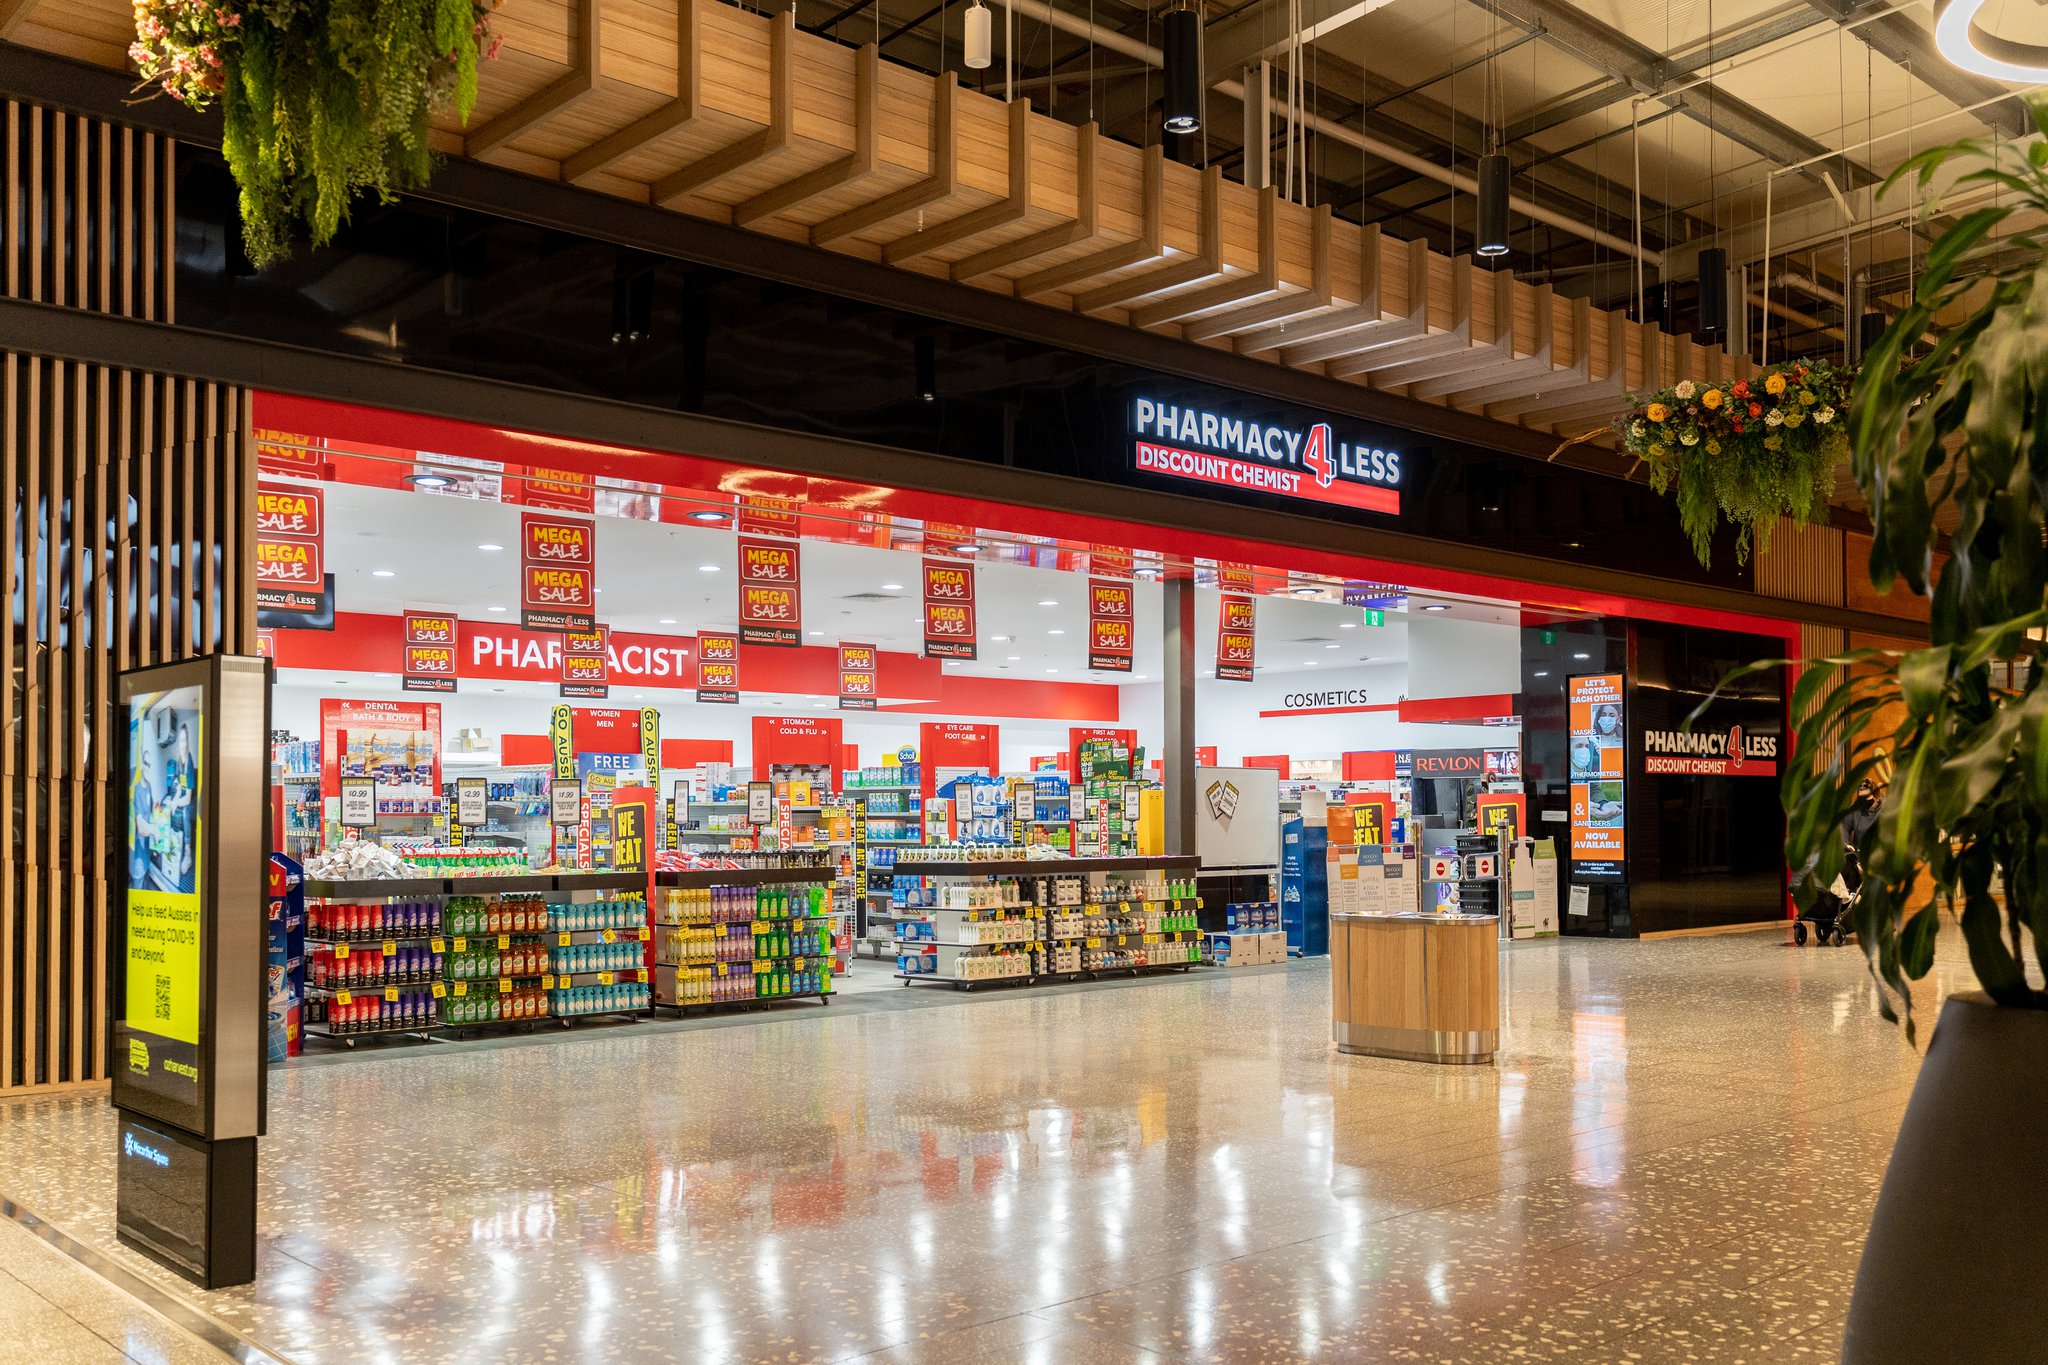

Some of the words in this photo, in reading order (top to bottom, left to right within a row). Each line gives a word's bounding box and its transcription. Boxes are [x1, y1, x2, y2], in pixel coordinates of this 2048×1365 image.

[1137, 398, 1302, 464] PHARMACY
[1303, 422, 1337, 489] 4
[1341, 443, 1400, 484] LESS
[1140, 445, 1230, 480] DISCOUNT
[1231, 463, 1300, 493] CHEMIST
[534, 527, 583, 546] MEGA
[539, 543, 582, 559] SALE
[748, 550, 789, 567] MEGA
[752, 563, 788, 579] SALE
[534, 571, 583, 589] MEGA
[929, 570, 965, 586] MEGA
[539, 586, 582, 603] SALE
[933, 583, 964, 597] SALE
[1095, 588, 1126, 603] MEGA
[296, 596, 316, 605] LESS
[748, 589, 789, 606] MEGA
[753, 603, 789, 619] SALE
[1099, 601, 1126, 614] SALE
[528, 614, 565, 625] PHARMACY
[574, 616, 589, 626] LESS
[930, 607, 966, 622] MEGA
[412, 619, 449, 631] MEGA
[934, 619, 965, 634] SALE
[1096, 622, 1127, 637] MEGA
[416, 630, 448, 641] SALE
[744, 630, 775, 638] PHARMACY
[1100, 634, 1126, 647] SALE
[573, 641, 601, 650] SALE
[704, 639, 732, 649] MEGA
[928, 644, 953, 652] PHARMACY
[412, 649, 449, 661] MEGA
[473, 635, 688, 676] PHARACIST
[707, 648, 732, 658] SALE
[845, 650, 869, 659] MEGA
[1228, 647, 1251, 659] SALE
[416, 659, 448, 671] SALE
[569, 658, 601, 669] MEGA
[847, 658, 869, 667] SALE
[1093, 656, 1115, 664] PHARMACY
[572, 668, 601, 678] SALE
[704, 665, 732, 675] MEGA
[407, 679, 435, 687] PHARMACY
[707, 675, 732, 684] SALE
[845, 674, 870, 684] MEGA
[1585, 679, 1606, 687] LET'S
[847, 683, 870, 692] SALE
[1577, 686, 1614, 695] PROTECT
[1285, 689, 1367, 708] COSMETICS
[1571, 695, 1595, 703] EACH
[1596, 694, 1621, 703] OTHER
[365, 702, 399, 711] DENTAL
[353, 713, 376, 721] BATH
[378, 713, 385, 721] &
[386, 713, 411, 722] BODY
[558, 708, 568, 731] GO
[590, 710, 620, 718] WOMEN
[597, 720, 614, 728] MEN
[644, 710, 654, 732] GO
[782, 718, 815, 726] STOMACH
[1573, 728, 1597, 736] MASKS
[1645, 730, 1727, 756] PHARMACY
[1727, 725, 1744, 768] 4
[1746, 736, 1777, 757] LESS
[558, 736, 570, 779] AUSSI
[594, 755, 630, 769] FREE
[646, 737, 658, 788] AUSSIE
[899, 752, 915, 760] Scholl
[1416, 757, 1481, 772] REVLON
[1647, 758, 1691, 773] DISCOUNT
[1692, 760, 1727, 774] CHEMIST
[1573, 770, 1621, 778] THERMOMETERS
[349, 790, 367, 798] $0.99
[464, 790, 480, 798] $2.99
[856, 803, 865, 820] WE
[1574, 803, 1585, 816] &
[617, 811, 635, 837] WE
[1354, 809, 1373, 827] WE
[1573, 819, 1611, 827] SANITISERS
[780, 804, 790, 850] SPECIA
[1100, 803, 1109, 857] SPECIALS
[451, 824, 463, 847] BEA
[579, 803, 590, 868] SPECIALS
[856, 822, 865, 846] BEAT
[1585, 832, 1608, 841] NOW
[1574, 840, 1621, 849] AVAILABLE
[615, 838, 642, 866] BEAT
[856, 848, 866, 868] ANY
[856, 870, 866, 900] PRICE
[131, 901, 145, 919] Help
[145, 906, 153, 917] us
[153, 904, 168, 919] feed
[168, 906, 192, 922] Aussies
[131, 925, 146, 939] need
[147, 927, 166, 945] during
[166, 930, 195, 945] COVID-19
[131, 947, 143, 960] and
[144, 948, 166, 964] beyond.
